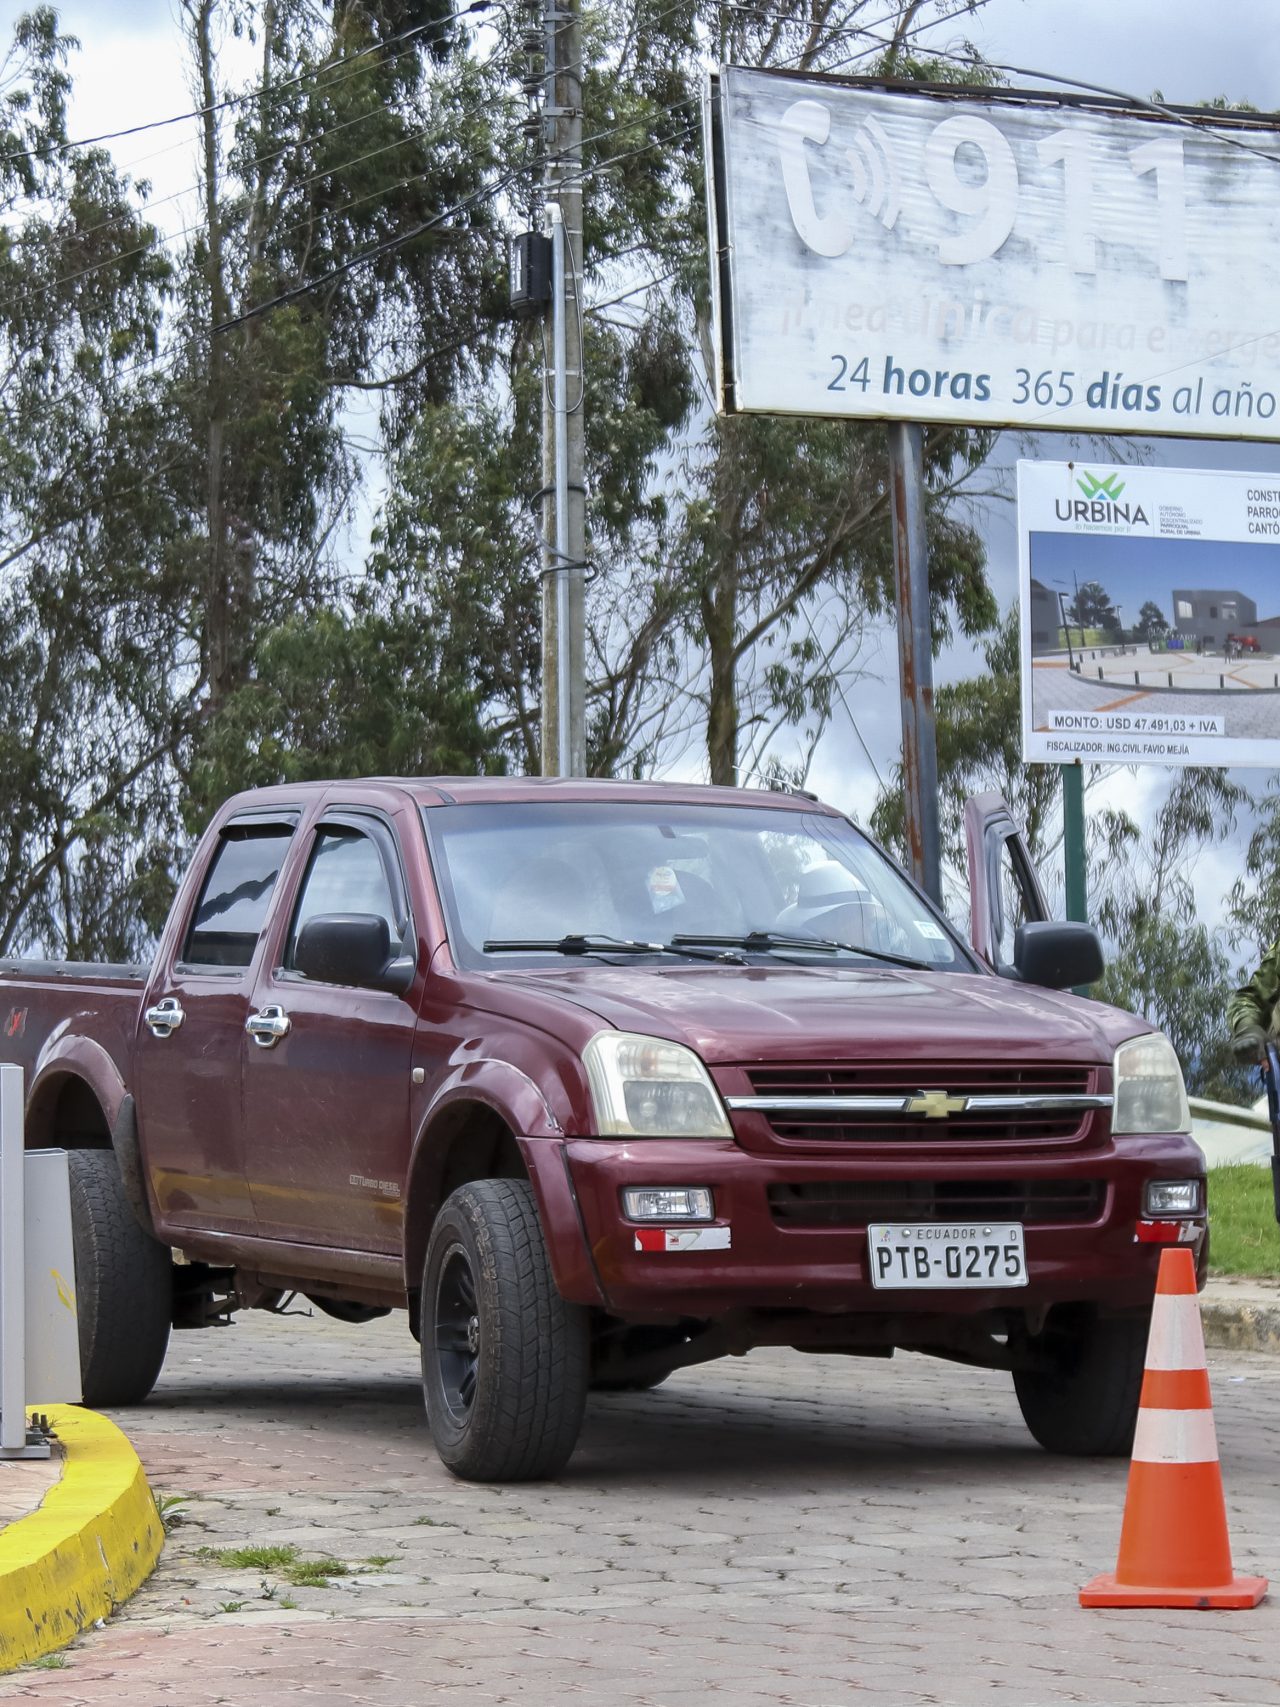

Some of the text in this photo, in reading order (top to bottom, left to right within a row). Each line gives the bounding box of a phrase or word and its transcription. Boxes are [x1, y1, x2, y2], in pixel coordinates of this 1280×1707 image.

[926, 114, 1188, 282] 911
[1051, 317, 1137, 356] para
[827, 354, 1276, 418] 24 horas 365 días al año
[1055, 499, 1150, 525] URBINA
[1054, 716, 1102, 729] MONTO:
[1106, 717, 1131, 730] USD
[1134, 718, 1186, 733] 47.491,03
[1199, 721, 1218, 733] IVA
[1046, 741, 1190, 756] FISCALIZADOR: ING.CIVIL FAVIO MEJÍA
[917, 1229, 1017, 1241] ECUADOR D
[876, 1245, 1021, 1279] PTB-0275
